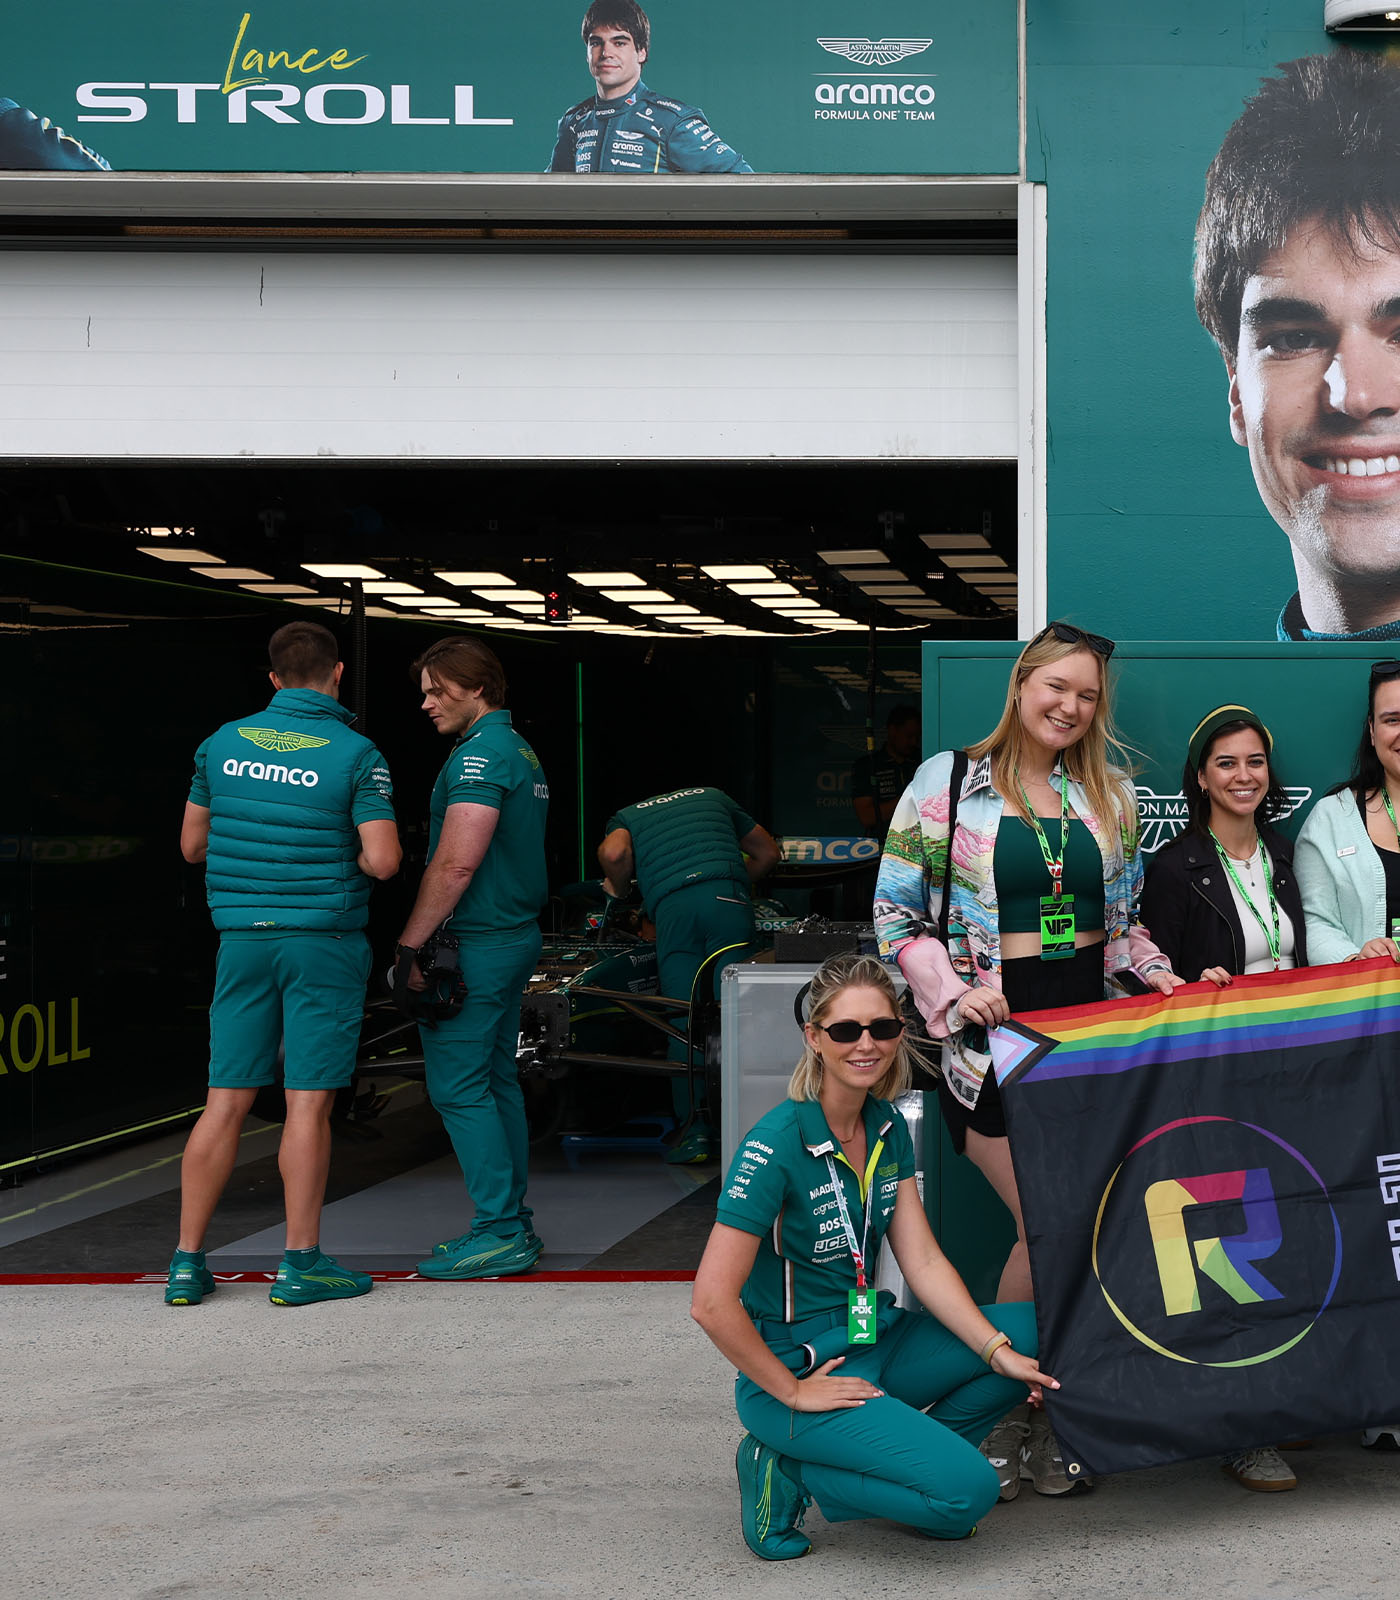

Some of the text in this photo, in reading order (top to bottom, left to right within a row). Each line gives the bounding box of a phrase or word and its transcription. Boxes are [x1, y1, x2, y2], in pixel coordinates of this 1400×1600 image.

[221, 13, 367, 95] Lance
[76, 82, 514, 126] STROLL
[814, 83, 936, 105] aramco
[814, 109, 870, 120] FORMULA
[903, 110, 935, 121] TEAM
[612, 142, 644, 152] aramco
[223, 758, 319, 787] aramco
[636, 787, 705, 809] aramco
[1044, 918, 1073, 936] VIP
[815, 1236, 849, 1252] JCB
